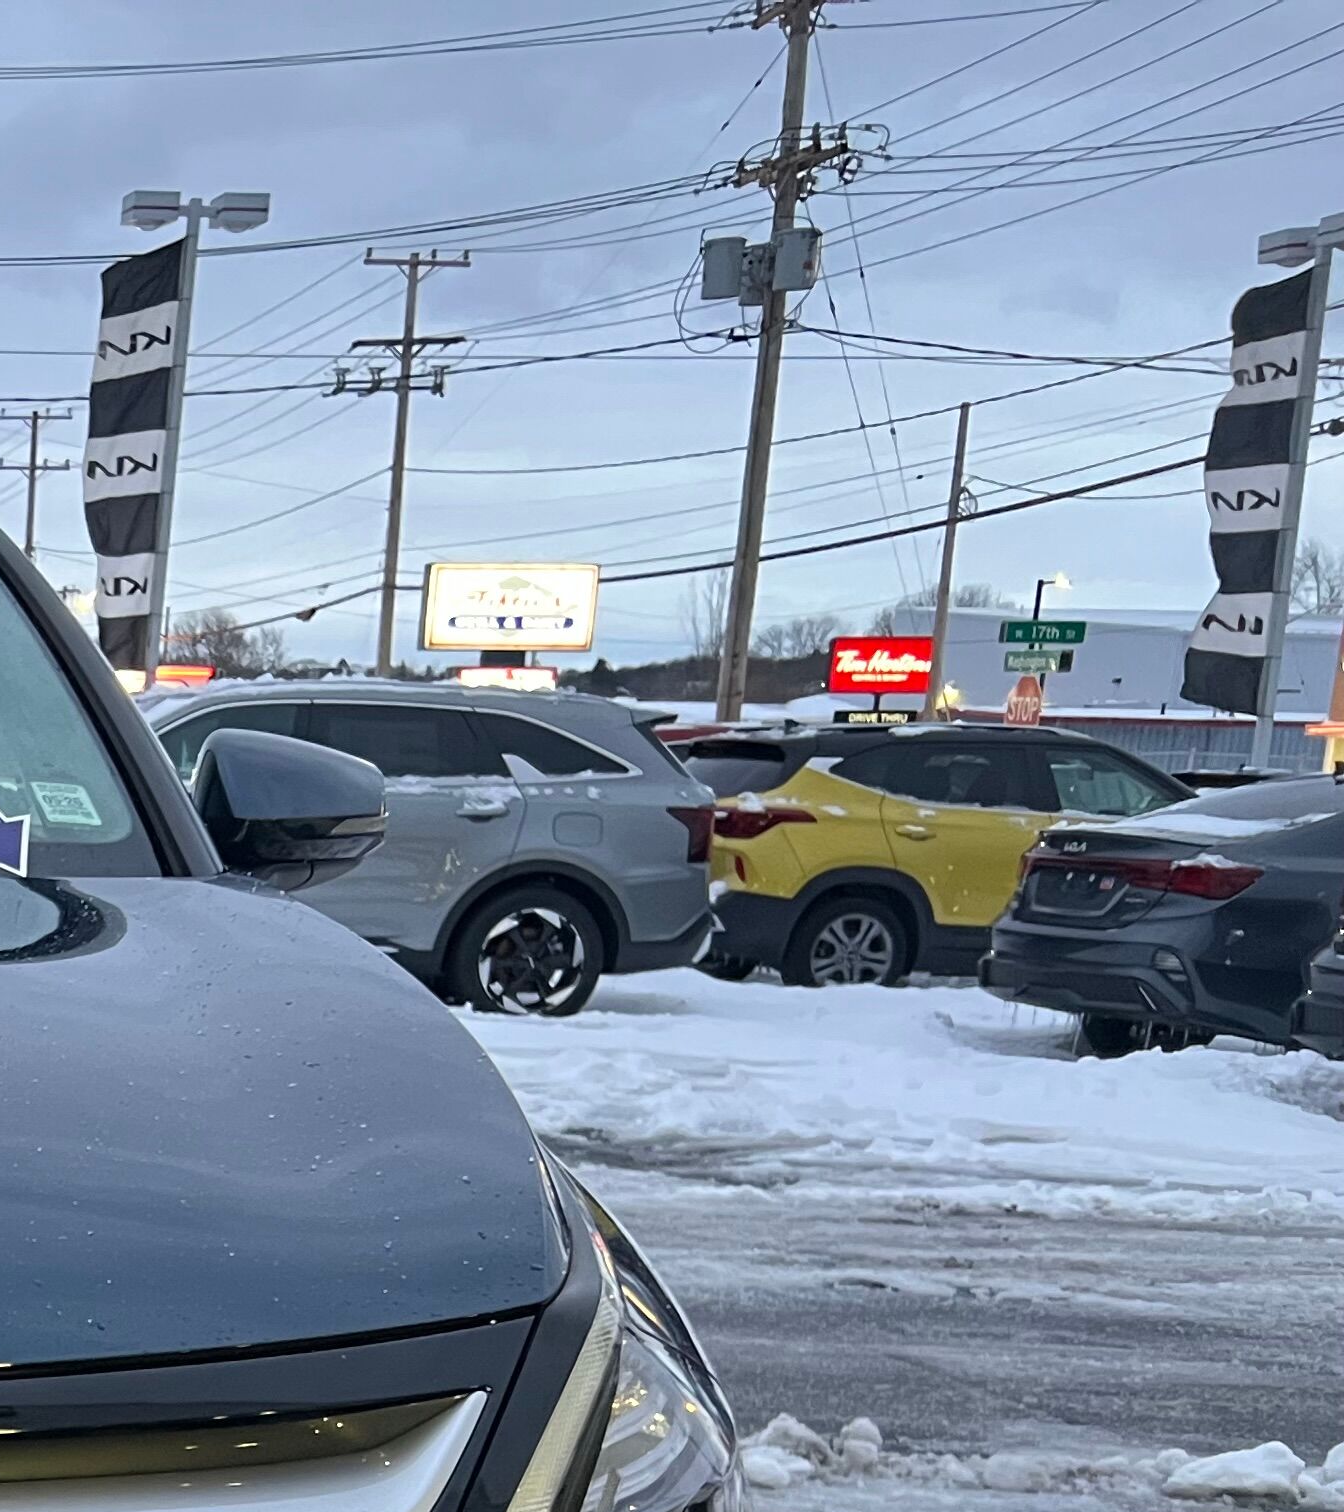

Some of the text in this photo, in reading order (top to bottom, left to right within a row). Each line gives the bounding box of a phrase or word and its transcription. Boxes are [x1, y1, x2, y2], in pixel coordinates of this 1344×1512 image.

[1032, 625, 1060, 640] 17th
[1007, 696, 1040, 722] STOP
[848, 713, 909, 725] DRIVE THRU
